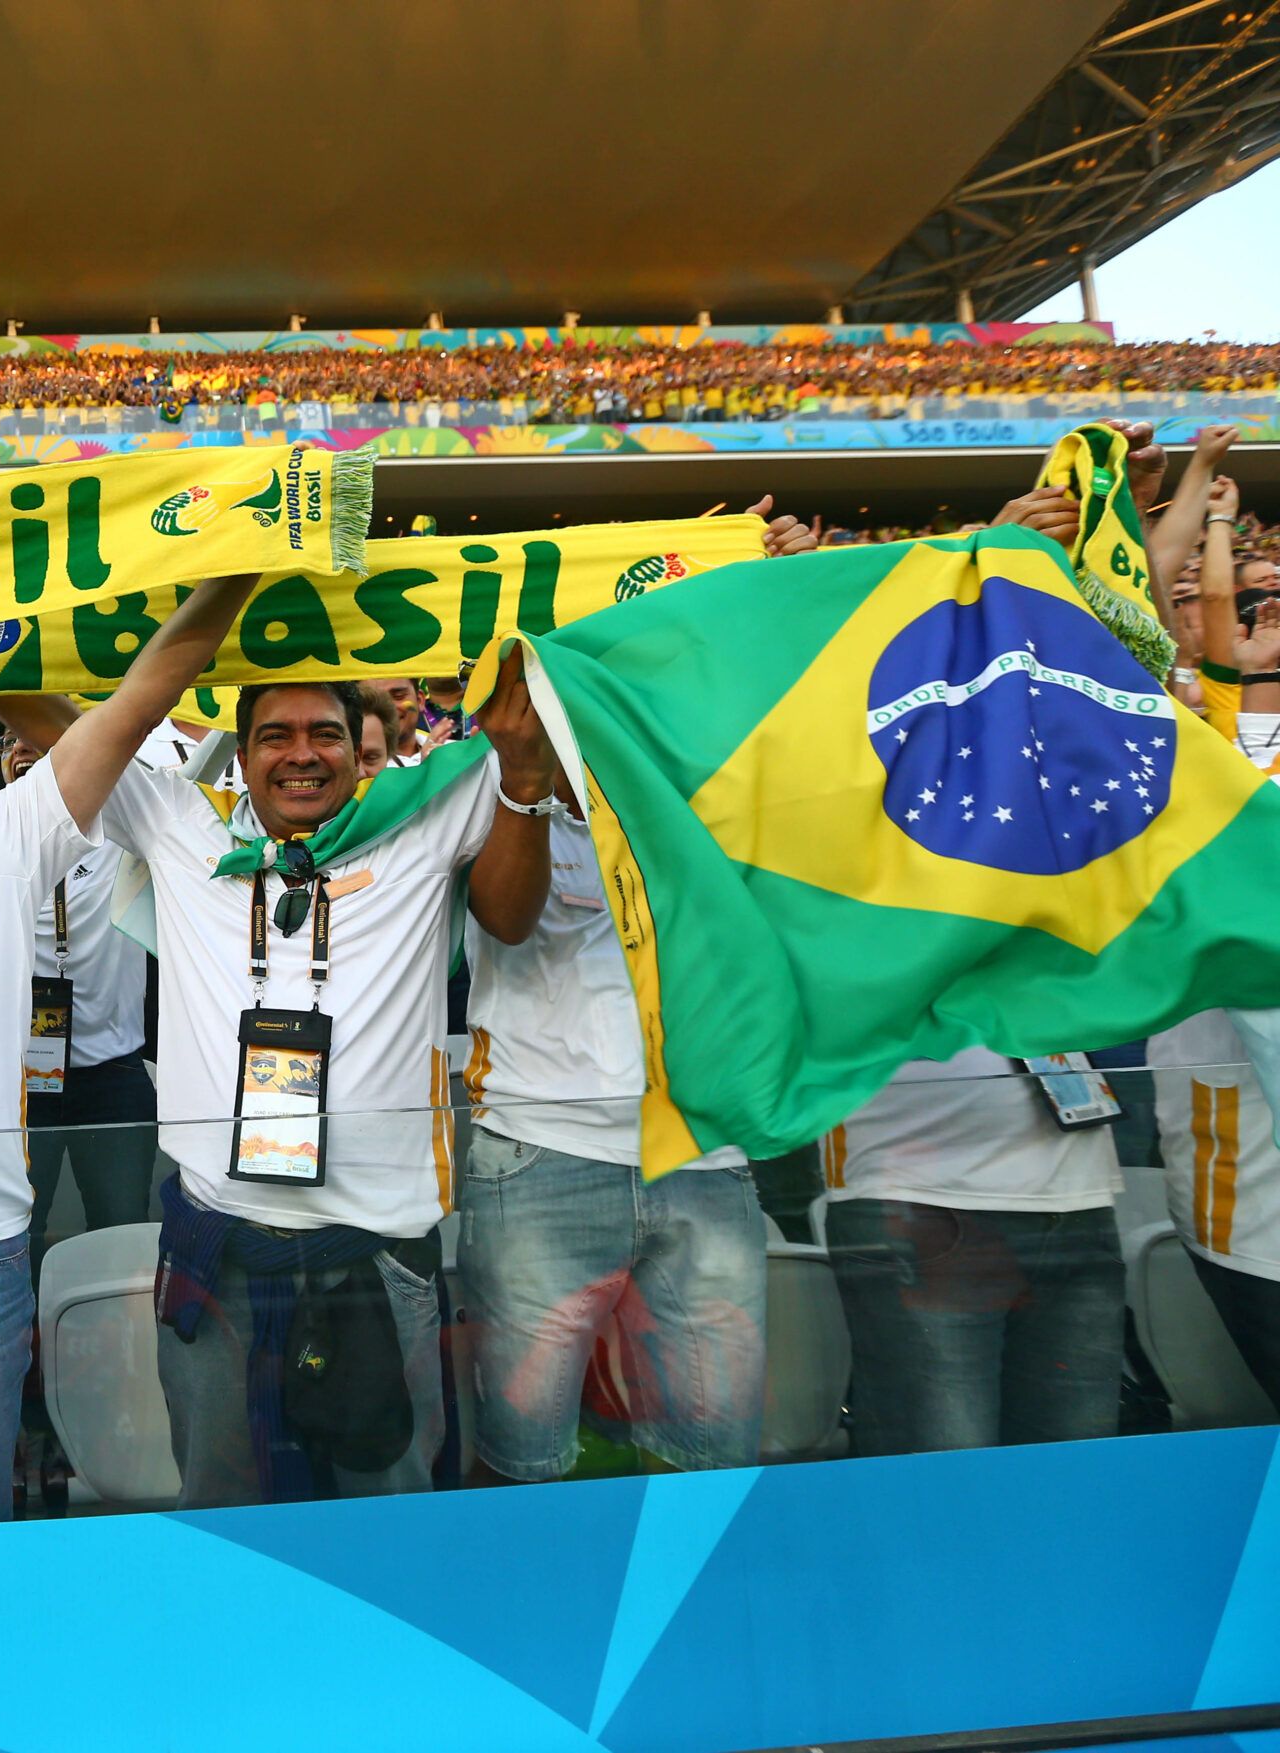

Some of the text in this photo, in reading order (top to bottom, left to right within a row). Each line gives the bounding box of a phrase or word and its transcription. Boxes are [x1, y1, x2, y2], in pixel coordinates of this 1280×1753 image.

[953, 421, 1016, 442] Paulo
[286, 447, 304, 550] FIFA WORLD CUP
[305, 469, 322, 522] Brasil
[874, 654, 1158, 725] ORDE E PROGRESSO
[254, 905, 264, 941] Continental
[318, 902, 328, 939] Continental
